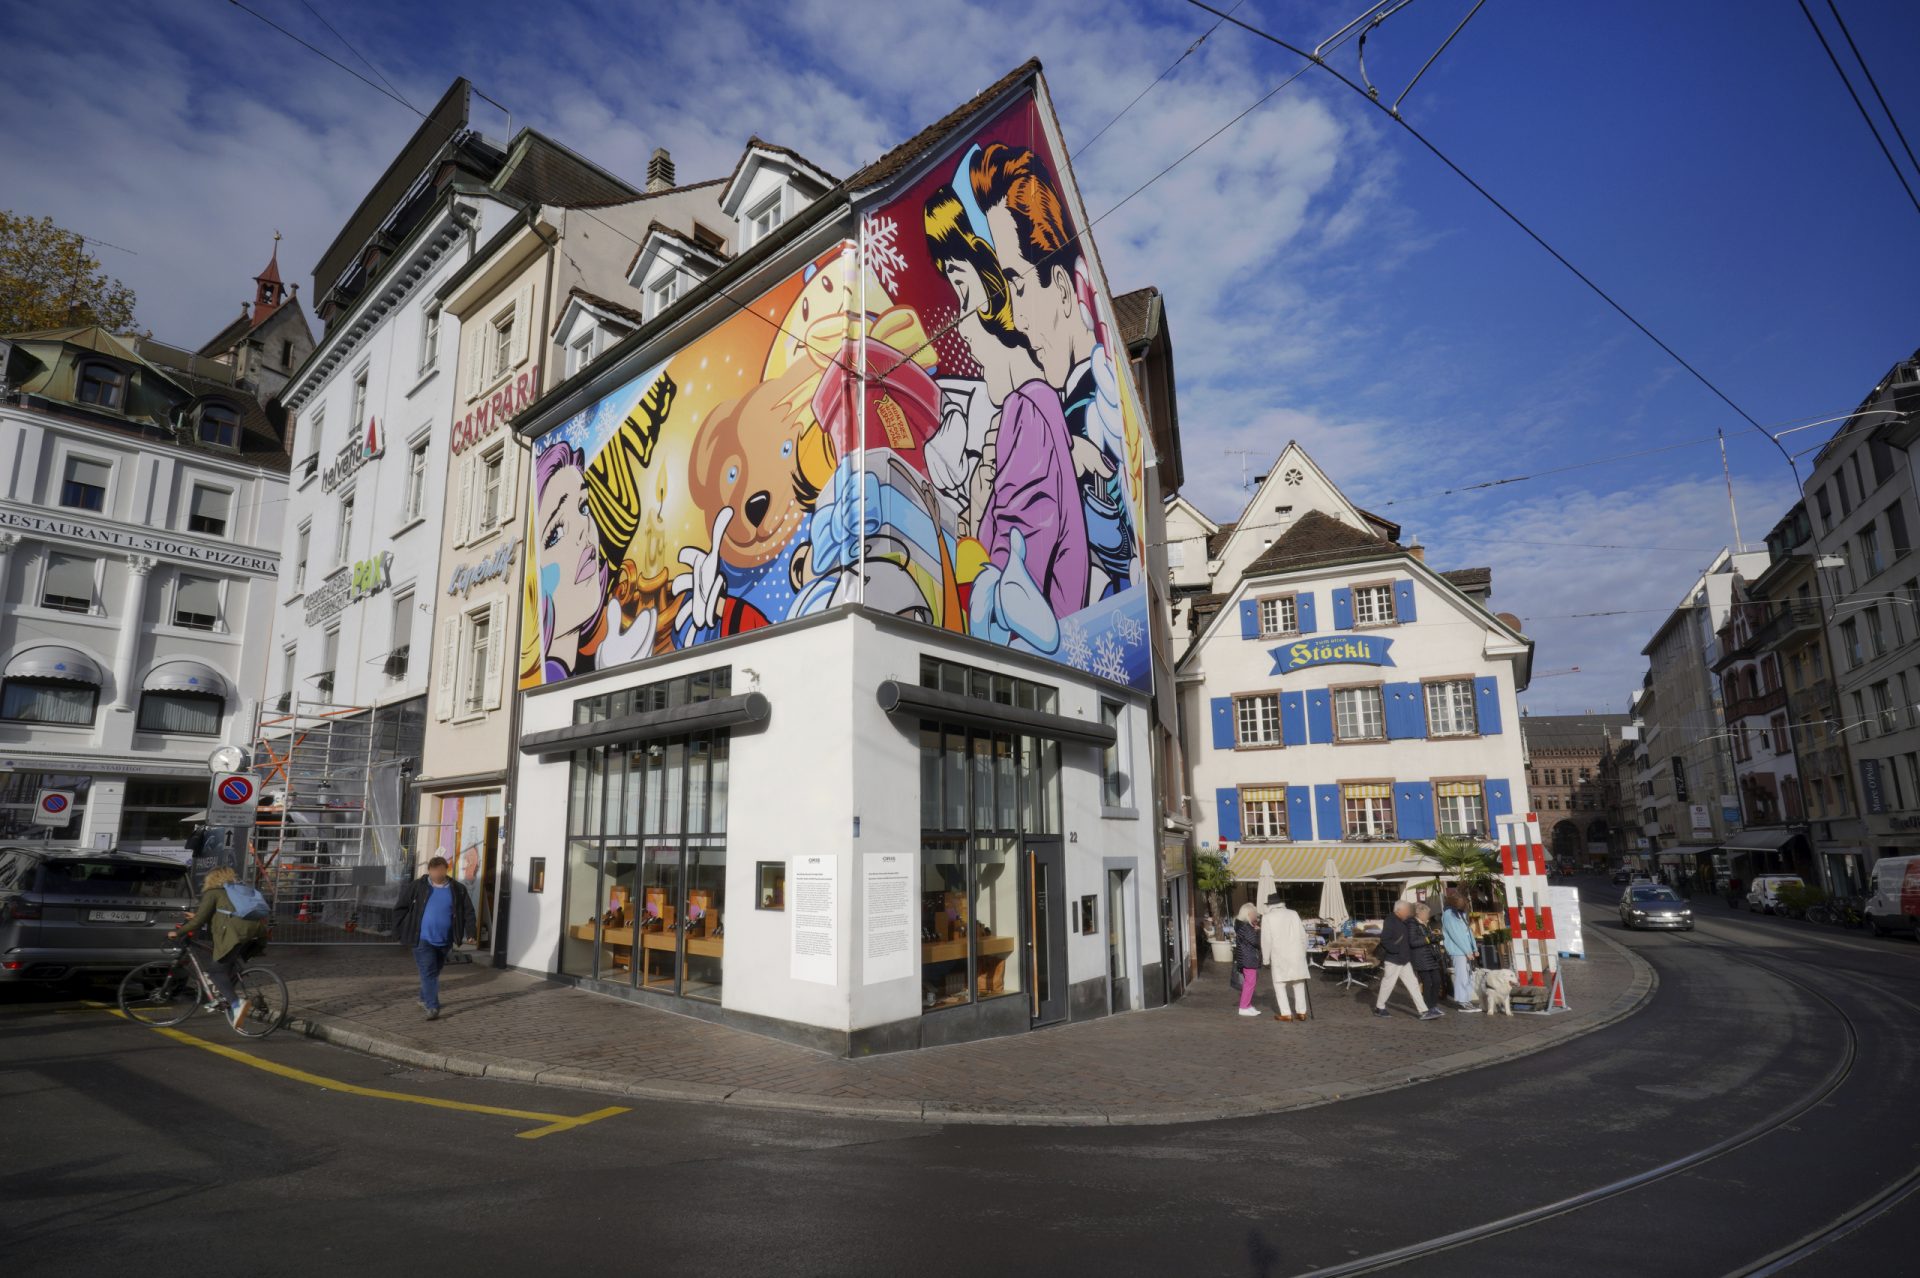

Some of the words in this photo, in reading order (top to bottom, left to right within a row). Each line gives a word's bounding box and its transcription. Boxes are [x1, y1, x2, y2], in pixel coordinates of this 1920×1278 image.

[452, 365, 538, 453] CAMPARI
[321, 439, 364, 492] helvetia
[128, 536, 139, 547] 1.
[143, 539, 202, 558] STOCK
[205, 550, 277, 571] PIZZERIA
[1290, 641, 1371, 668] Stöckli
[1070, 831, 1077, 843] 22
[95, 911, 106, 920] BL
